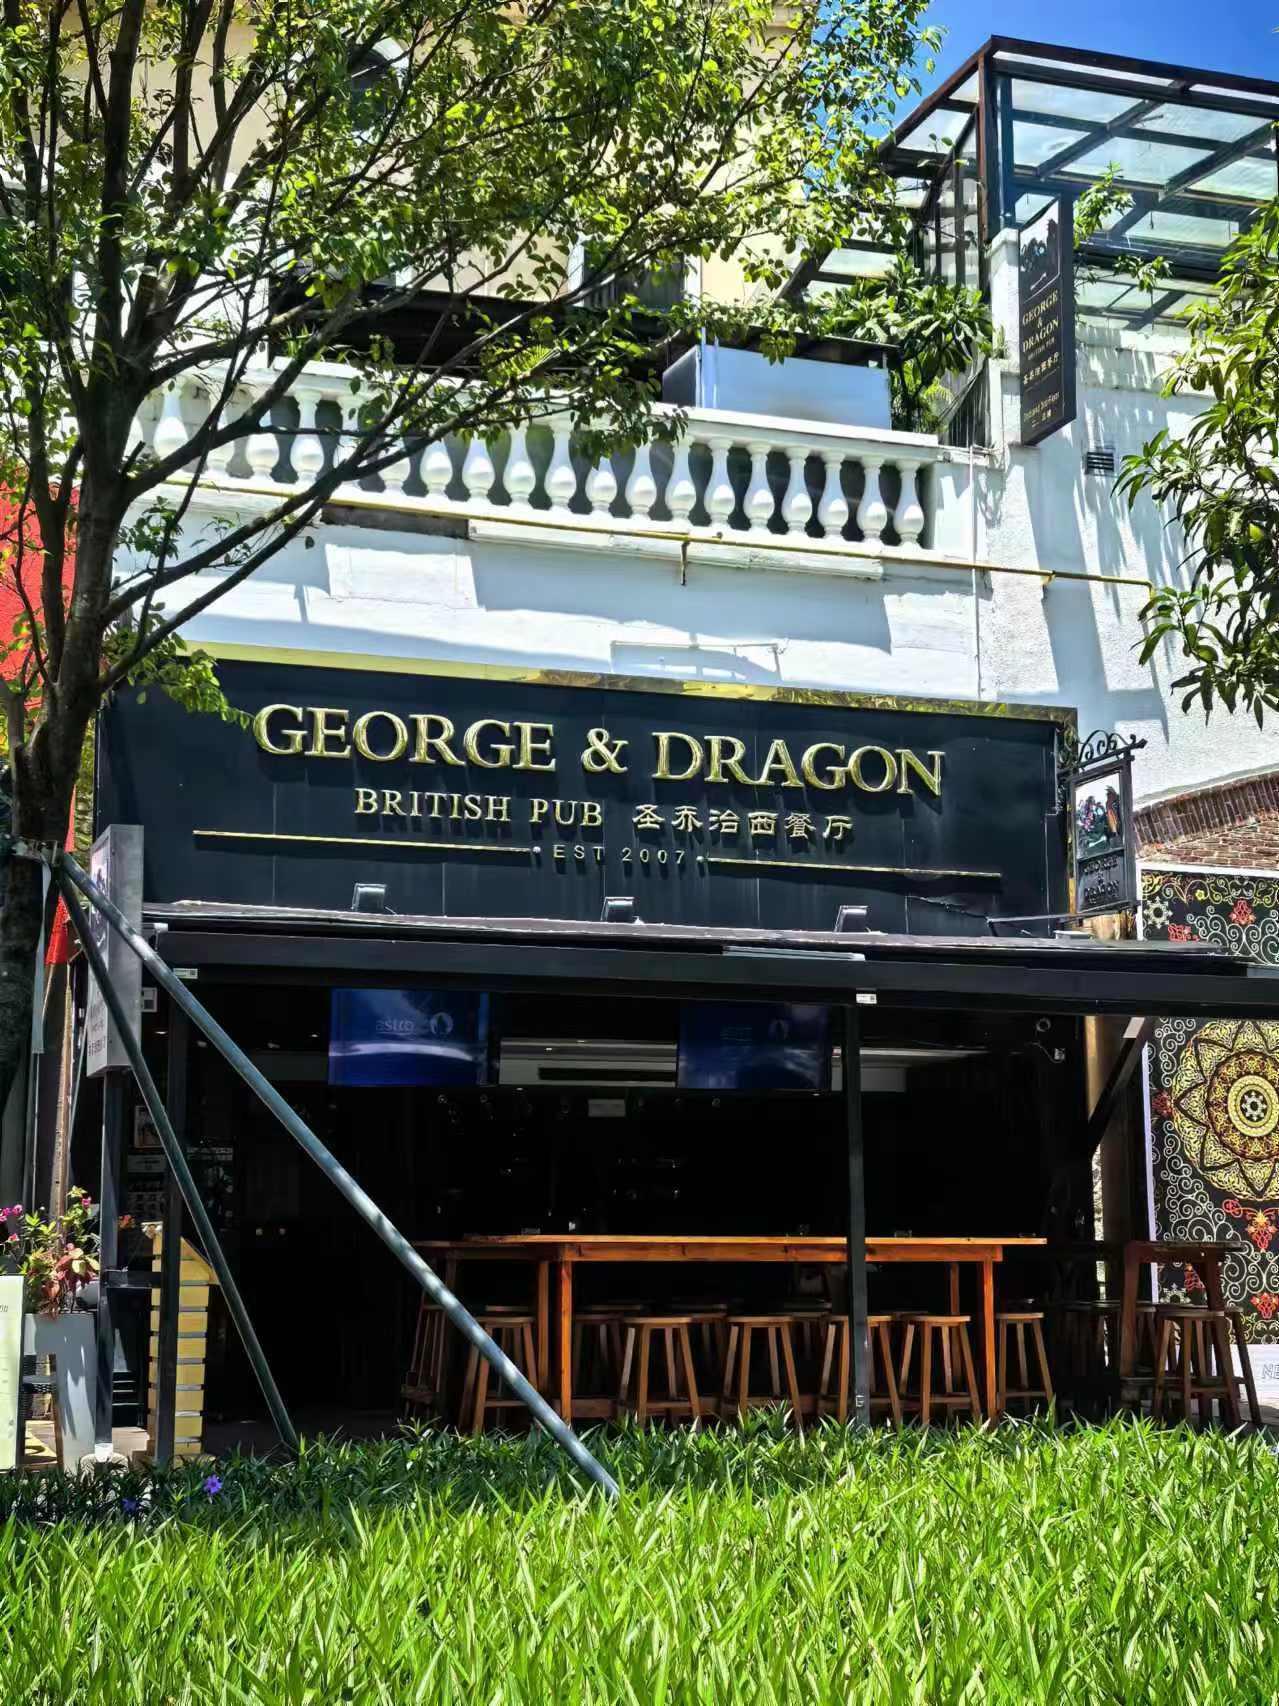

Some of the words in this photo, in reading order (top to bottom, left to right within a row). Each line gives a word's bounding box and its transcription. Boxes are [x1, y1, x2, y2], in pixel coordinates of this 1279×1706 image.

[1023, 289, 1058, 327] GEORGE
[1023, 314, 1058, 352] DRAGON
[253, 703, 557, 772] GEORGE
[580, 727, 630, 774] &
[652, 731, 947, 797] DRAGON
[354, 787, 512, 822] BRITISH
[529, 798, 603, 827] PUB
[632, 803, 854, 841] 圣乔治西餐厅
[552, 844, 605, 861] EST
[621, 847, 686, 864] 2007
